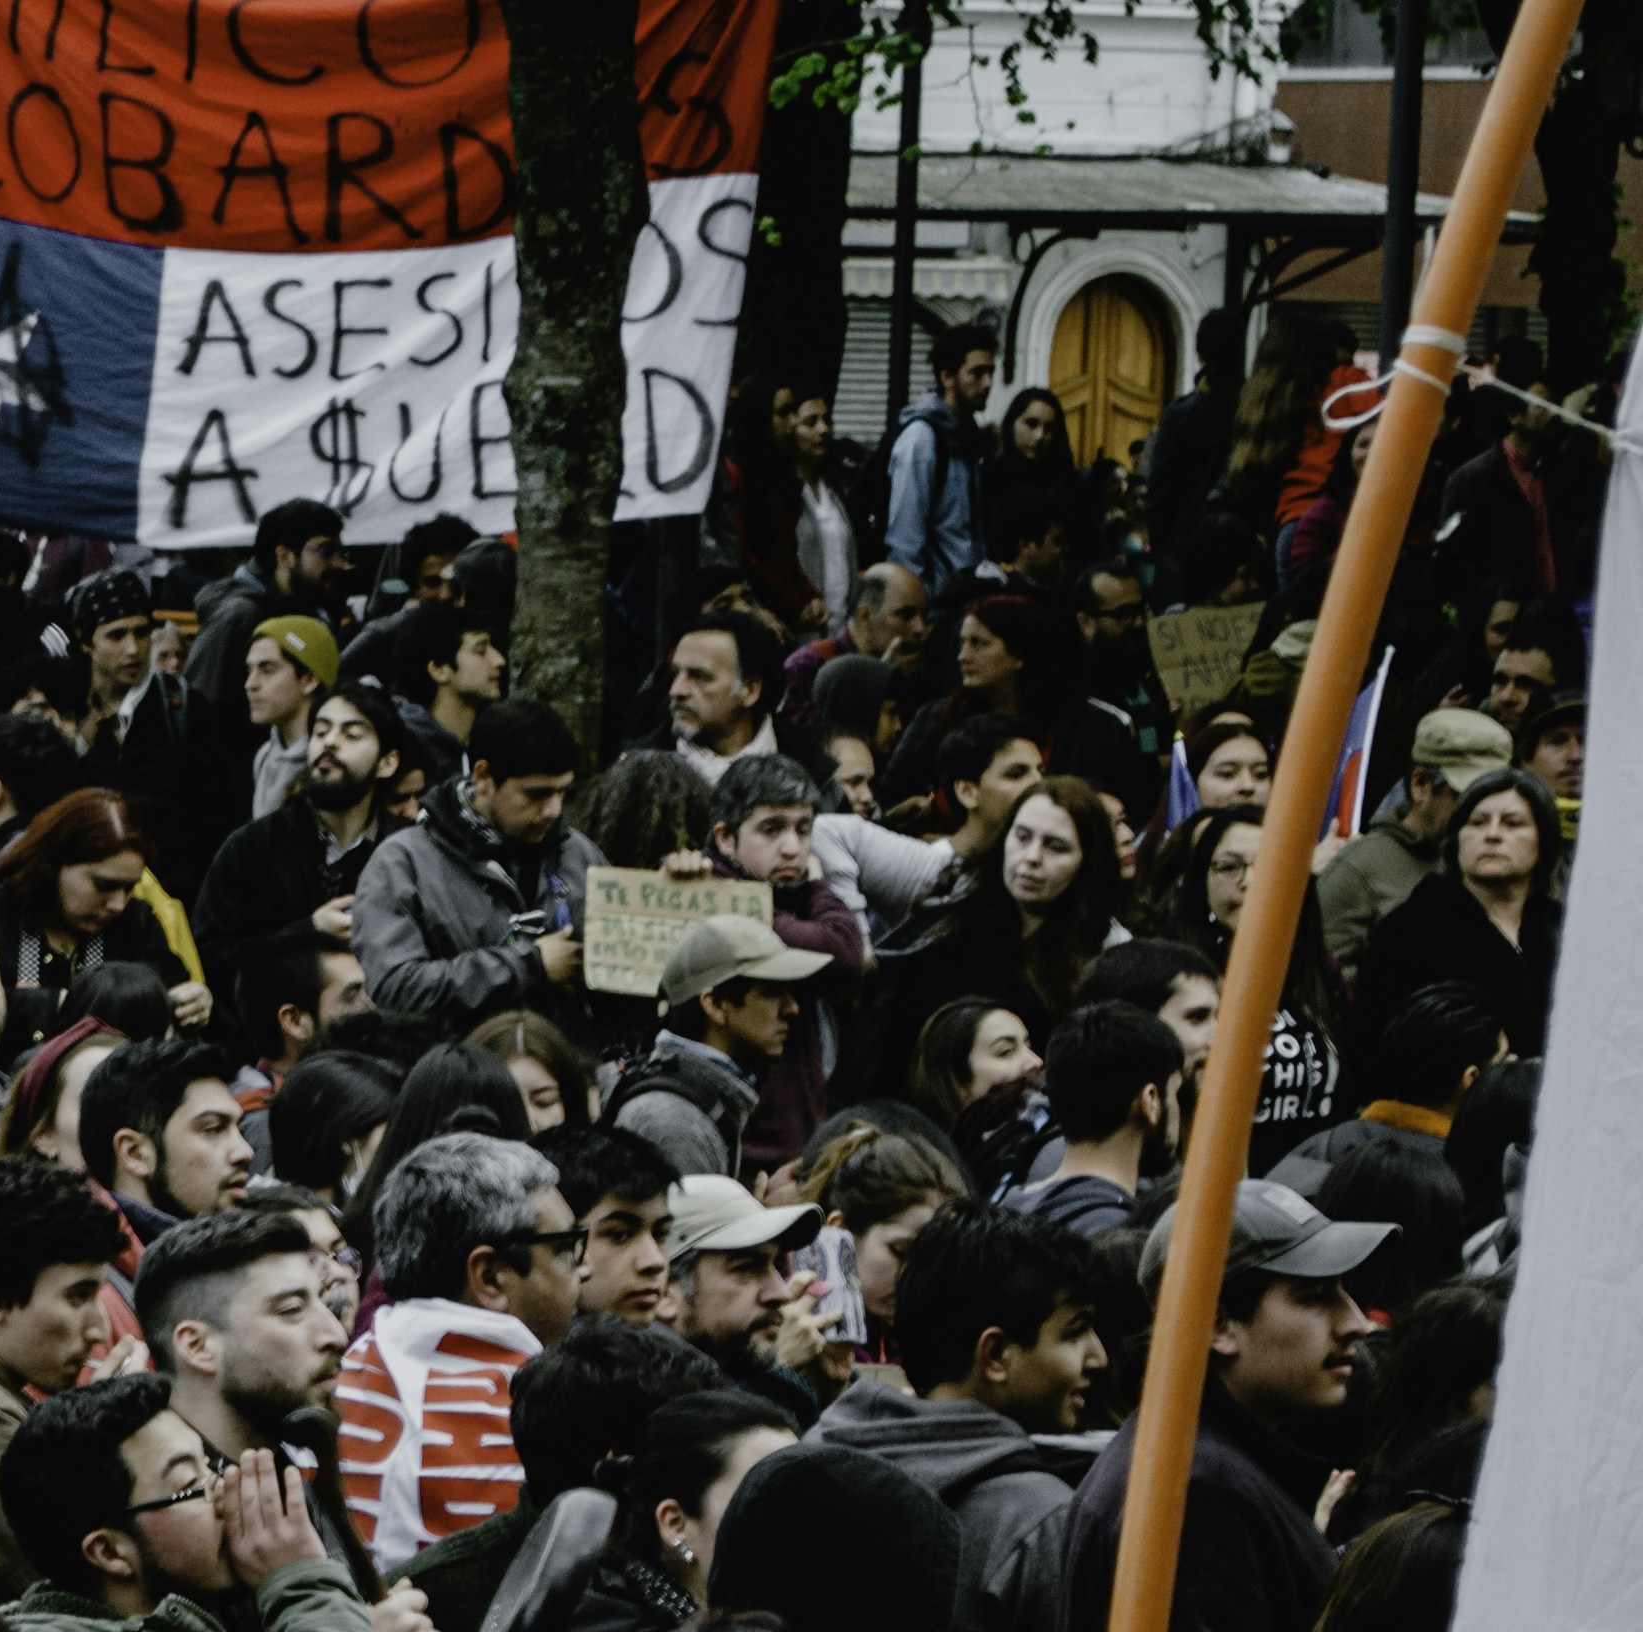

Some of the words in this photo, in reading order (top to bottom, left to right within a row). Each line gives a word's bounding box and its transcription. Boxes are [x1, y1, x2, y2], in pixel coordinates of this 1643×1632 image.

[176, 198, 755, 380] ASESIOS
[165, 410, 258, 528] A
[310, 369, 717, 514] $UED
